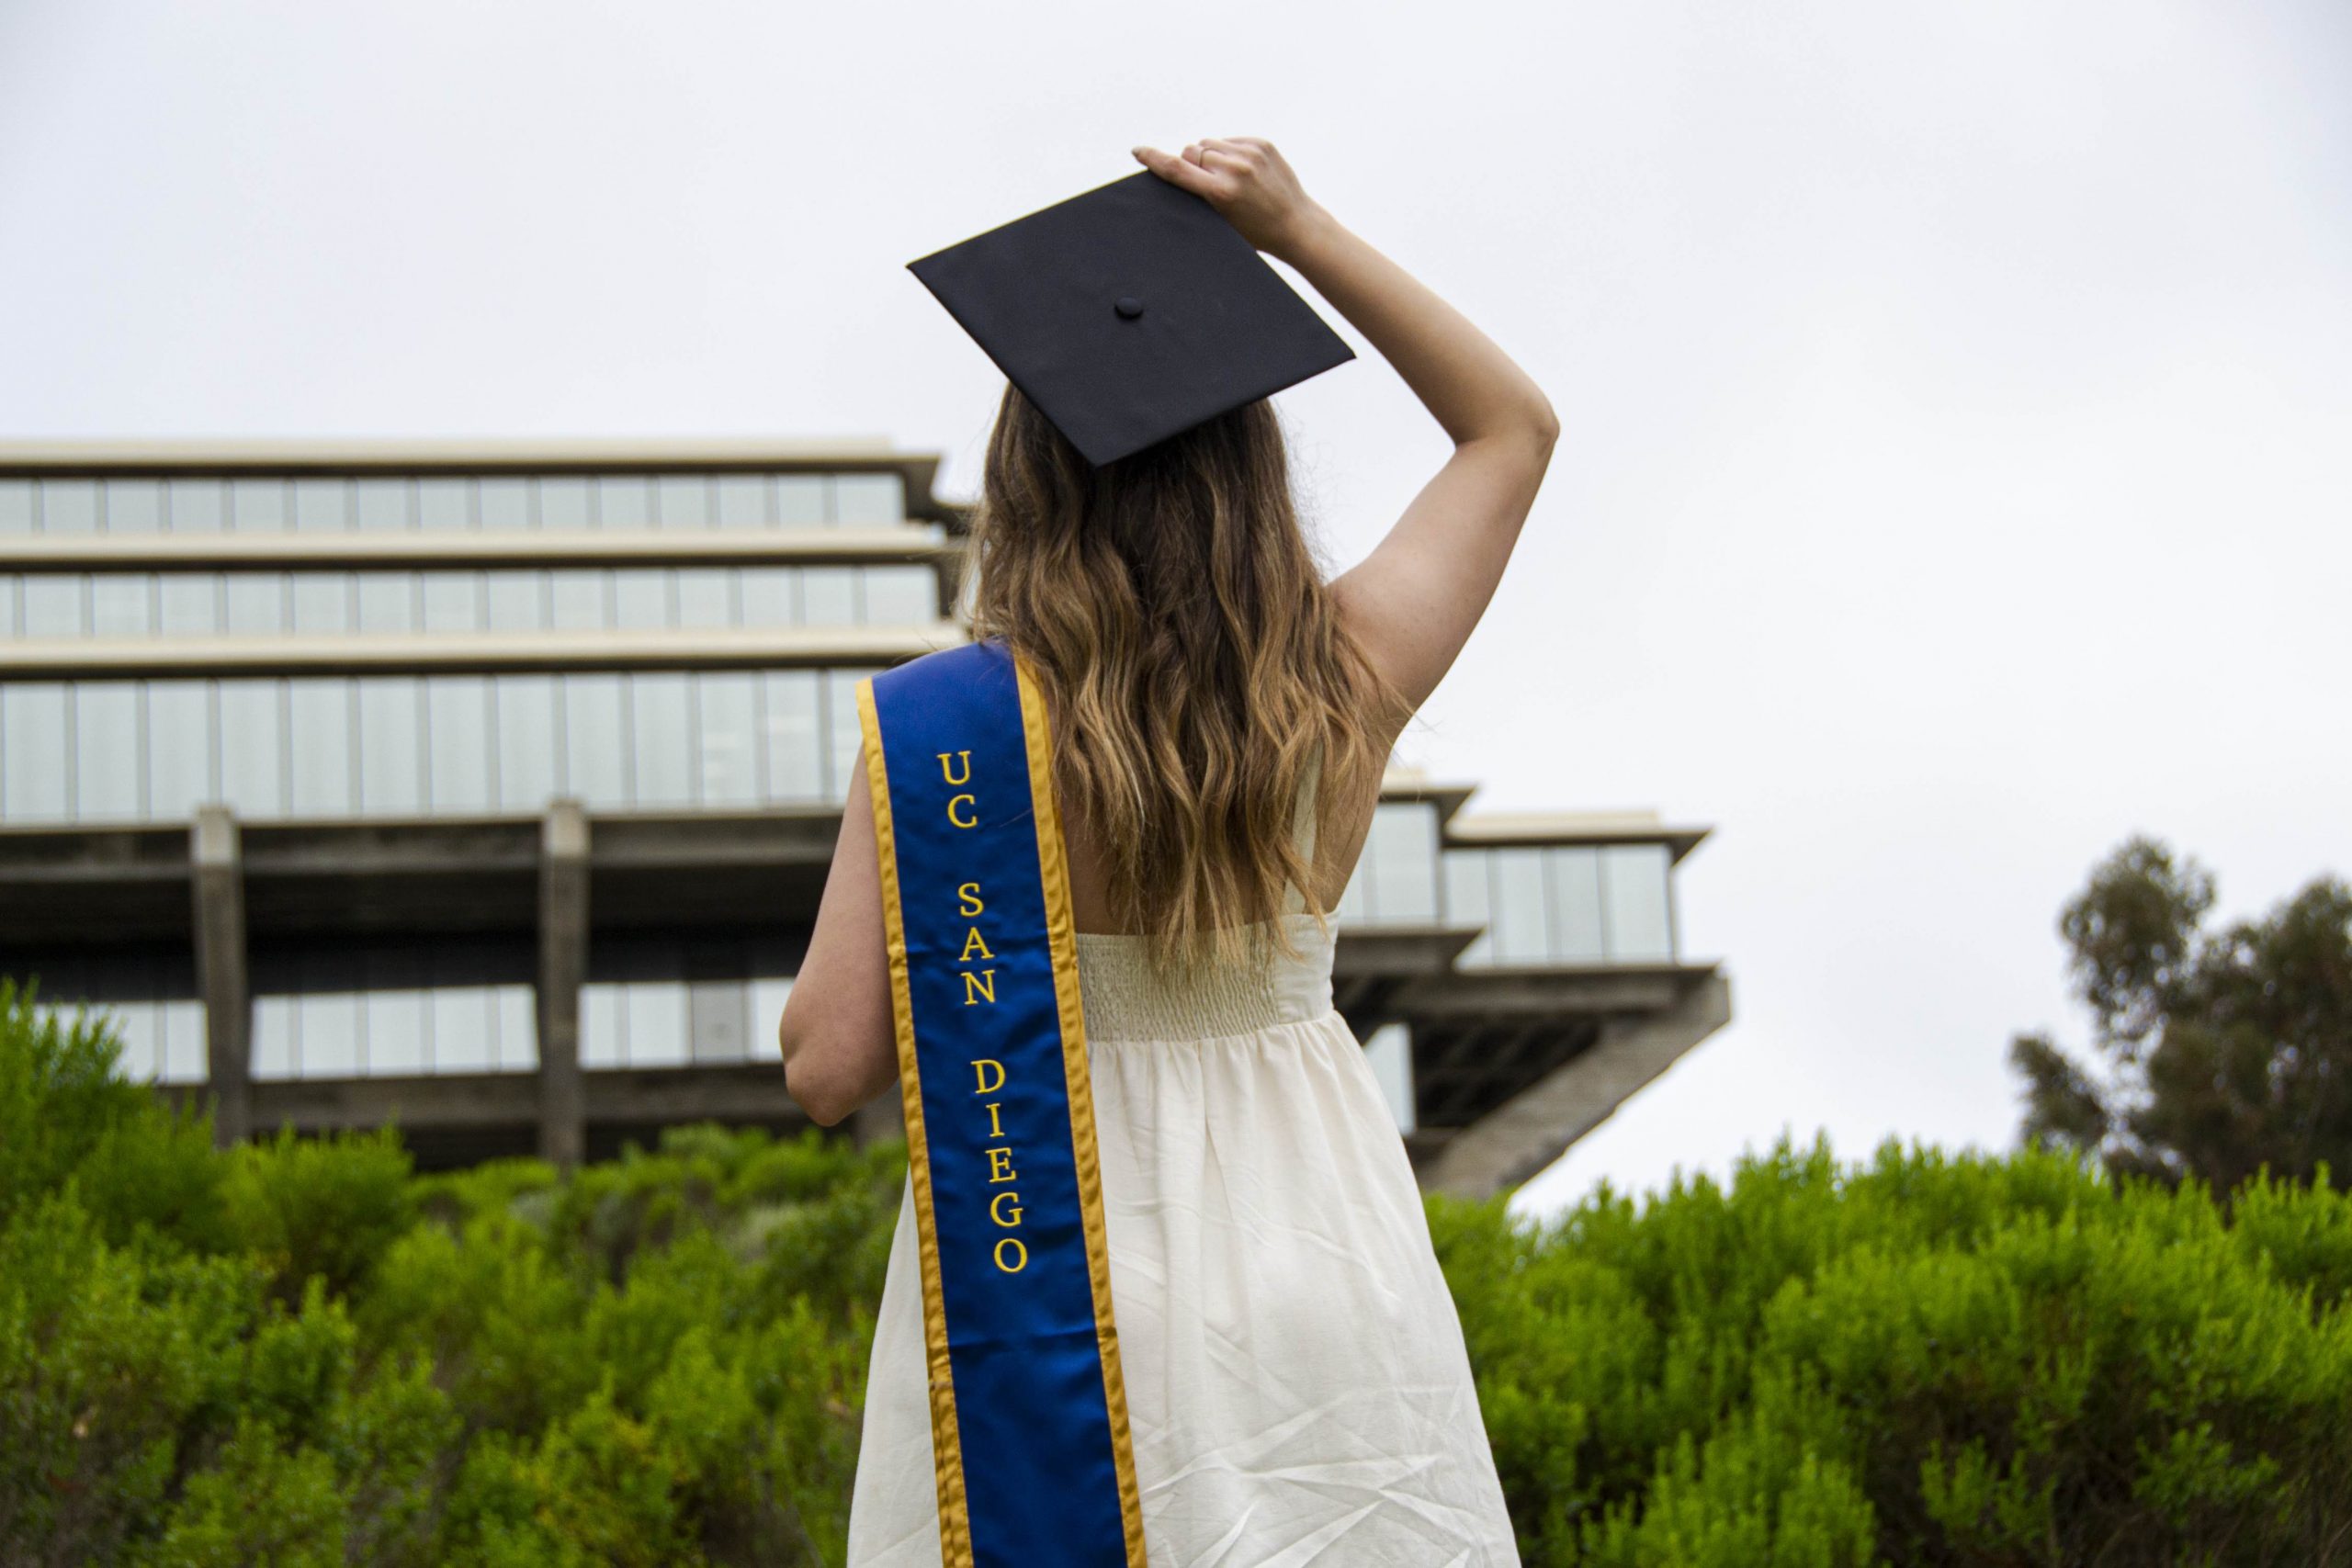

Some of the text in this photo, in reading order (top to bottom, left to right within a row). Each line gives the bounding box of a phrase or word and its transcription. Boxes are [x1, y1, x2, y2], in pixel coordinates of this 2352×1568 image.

[936, 750, 1028, 1273] UC SAN DIEGO
